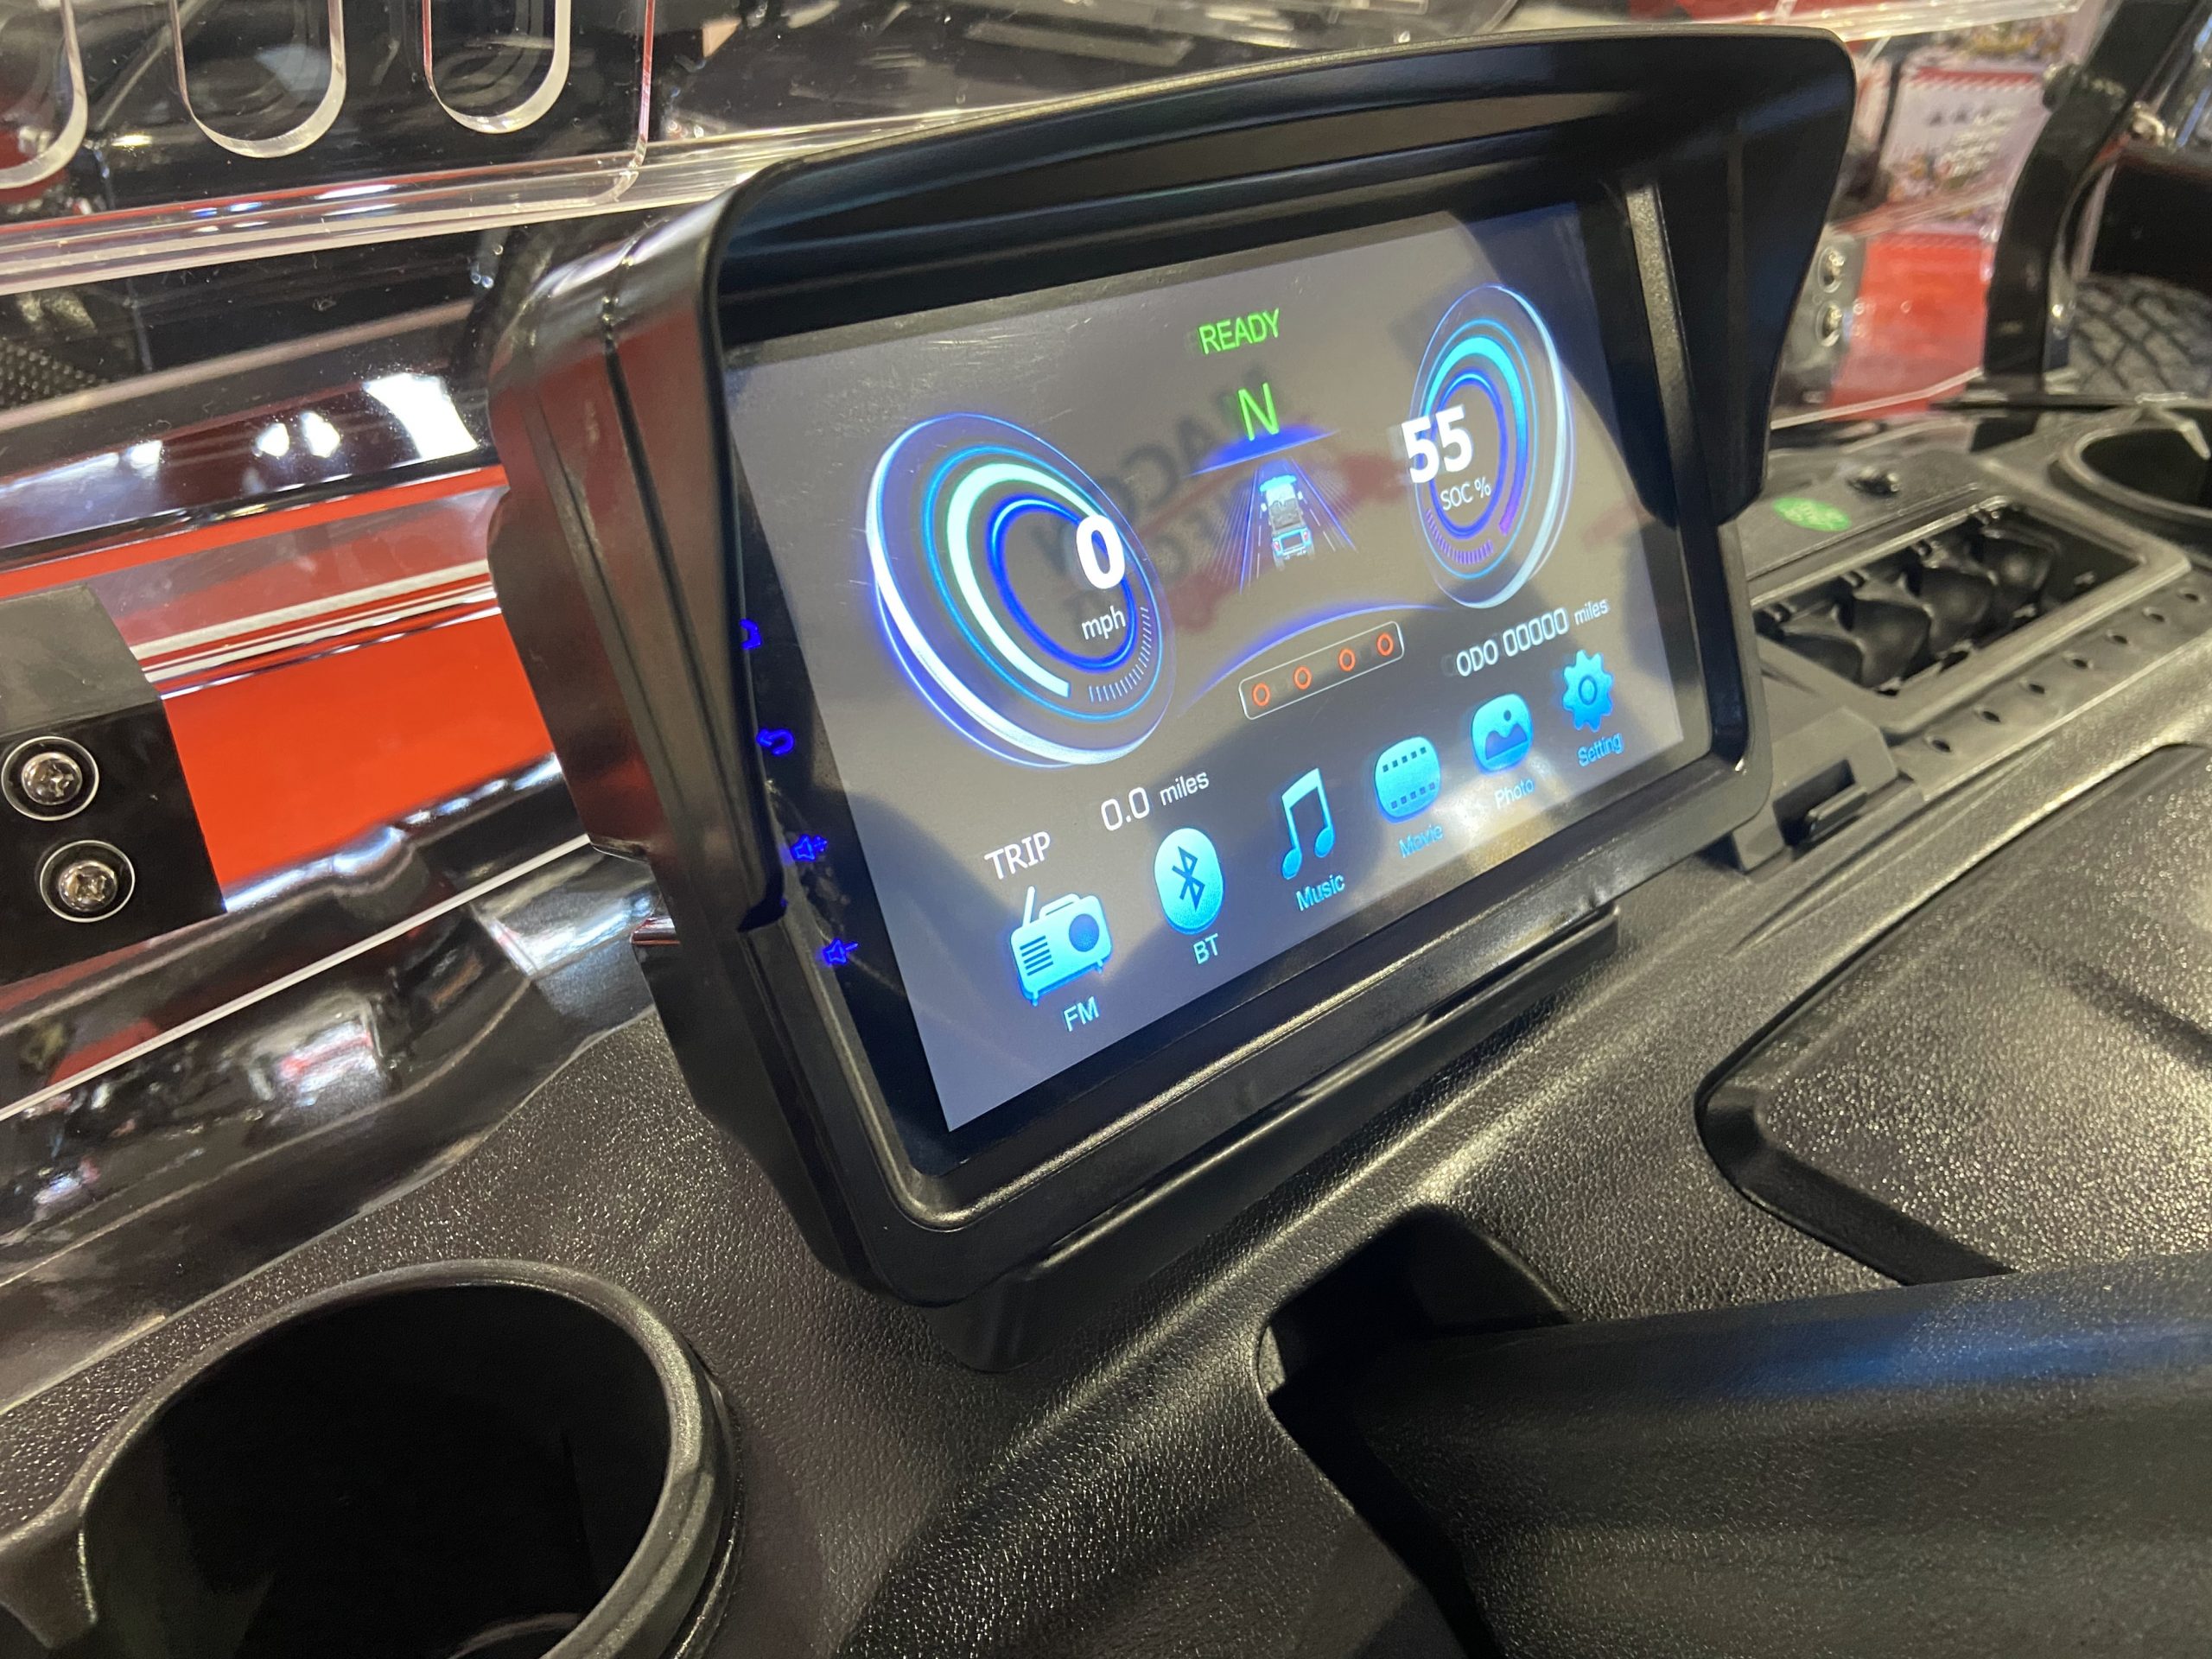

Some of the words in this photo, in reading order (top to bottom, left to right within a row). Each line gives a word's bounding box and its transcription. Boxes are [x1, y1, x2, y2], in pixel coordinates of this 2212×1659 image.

[1198, 308, 1280, 355] READY
[1238, 382, 1280, 441] N
[1401, 404, 1473, 483] 55
[1440, 481, 1473, 511] SOC
[1474, 476, 1491, 499] %
[1077, 514, 1125, 589] 0
[1082, 605, 1126, 640] mph
[1456, 639, 1499, 677] ODO
[1502, 607, 1570, 657] 00000
[1573, 599, 1610, 626] miles
[1577, 733, 1624, 767] Setting
[1494, 778, 1535, 810] Photo
[983, 831, 1051, 880] TRIP
[1101, 786, 1150, 831] 0.0
[1160, 772, 1210, 806] miles
[1398, 823, 1444, 858] Movie
[1295, 874, 1345, 912] Music
[1193, 933, 1218, 964] BT
[1063, 995, 1100, 1032] FM
